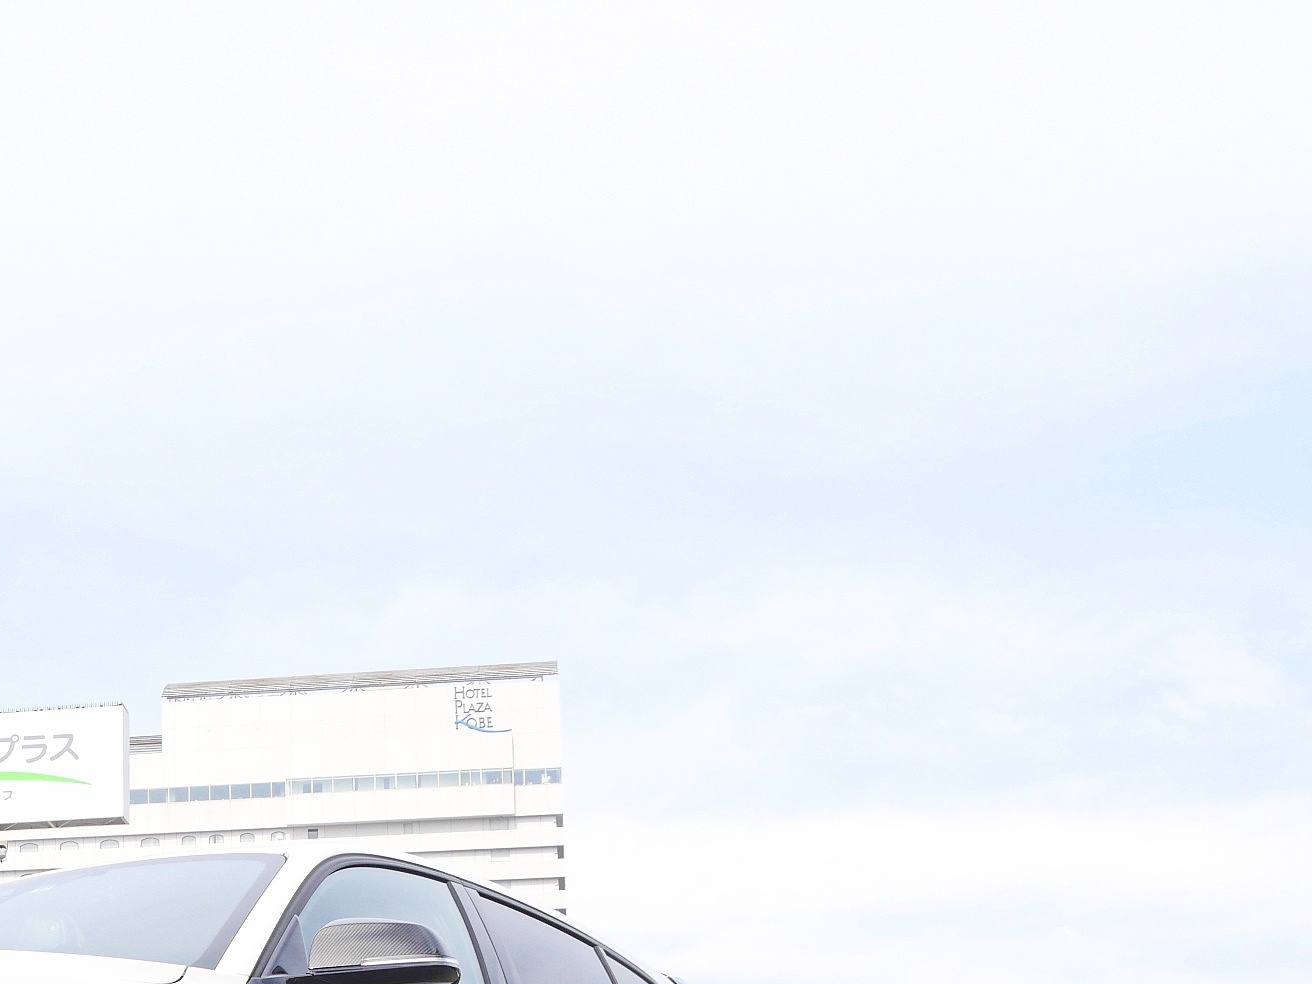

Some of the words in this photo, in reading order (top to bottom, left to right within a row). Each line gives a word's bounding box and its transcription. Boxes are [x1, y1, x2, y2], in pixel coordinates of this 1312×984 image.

[454, 686, 493, 699] HOTEL
[454, 699, 493, 714] PLAZA
[454, 714, 494, 730] KOBE
